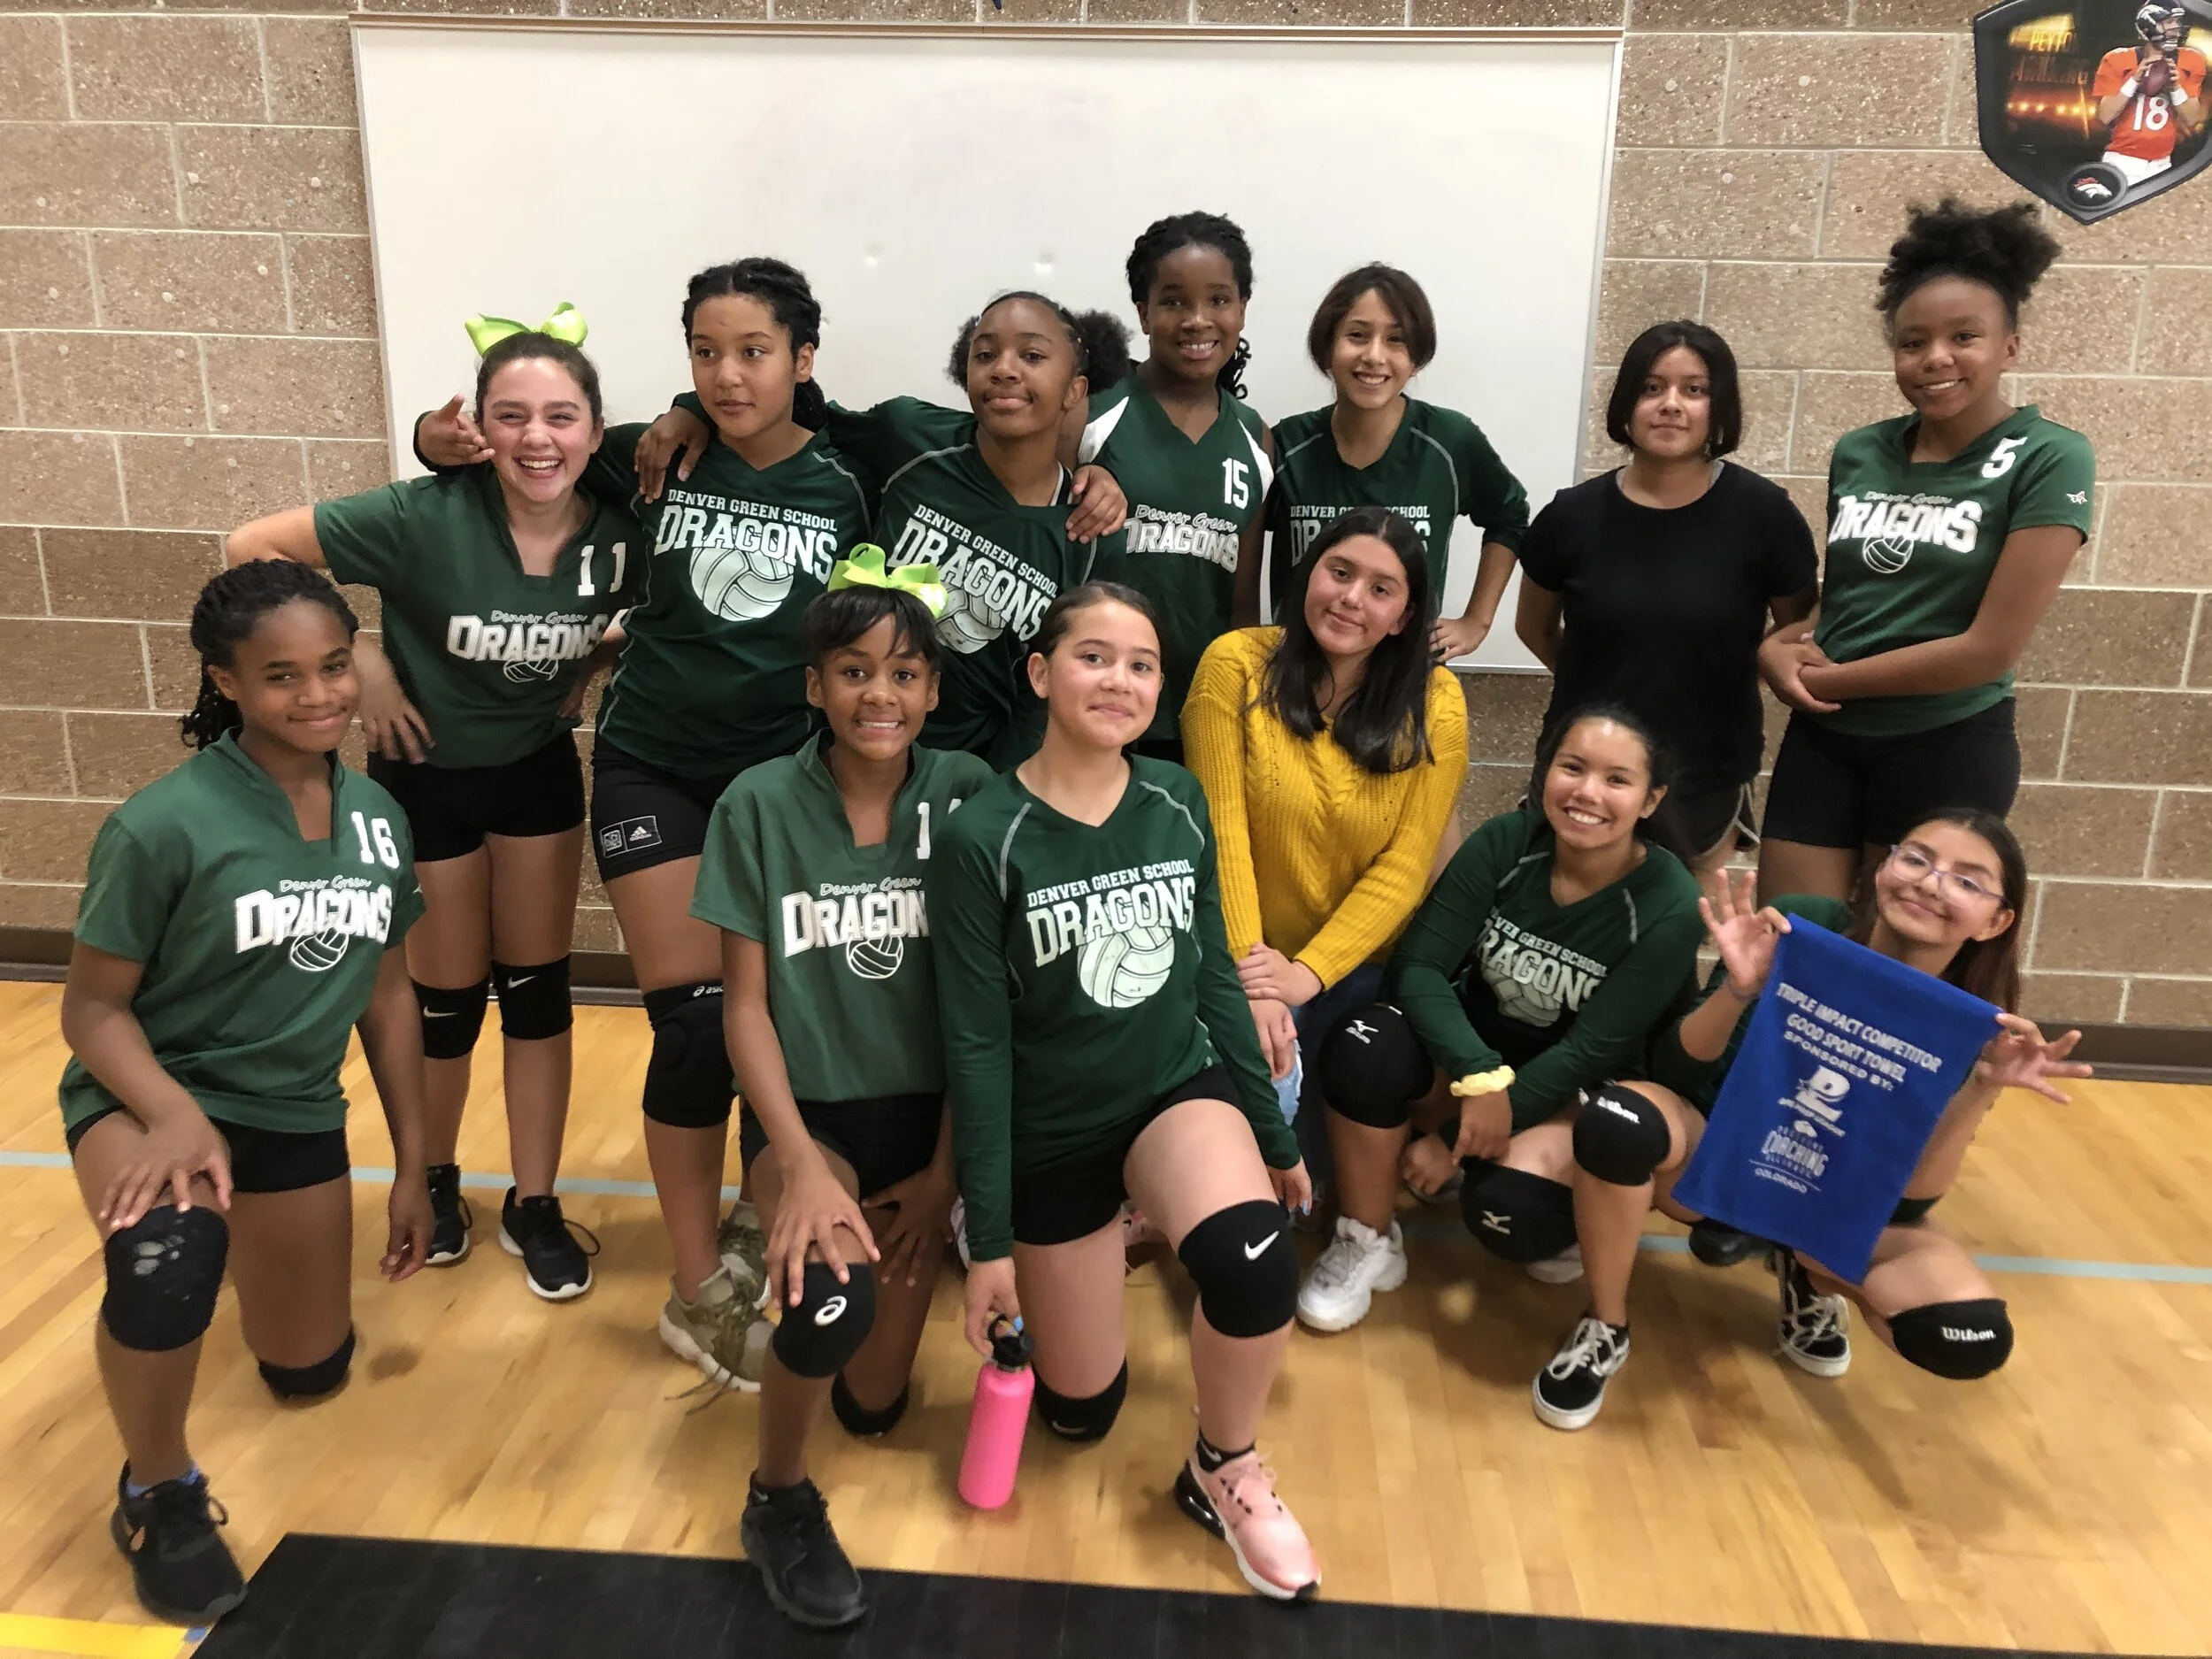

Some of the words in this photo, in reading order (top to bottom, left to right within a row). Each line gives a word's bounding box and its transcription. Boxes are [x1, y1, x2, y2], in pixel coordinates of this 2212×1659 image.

[2132, 95, 2170, 131] 18
[1222, 457, 1249, 510] 15
[1981, 436, 2028, 479] 5
[667, 488, 726, 511] DENVER
[730, 499, 780, 520] GREEN
[783, 509, 838, 532] SCHOOL
[1135, 504, 1191, 525] Denver
[1192, 512, 1238, 533] Green
[1290, 505, 1336, 518] DENVER
[1828, 494, 1984, 554] DRAGONS
[654, 504, 838, 585] DRAGONS
[914, 503, 972, 543] DENVER
[972, 535, 1019, 570] GREEN
[1018, 562, 1058, 598] SCHOOL
[887, 517, 1053, 641] DRAGONS
[490, 610, 542, 624] Denver
[544, 611, 588, 624] Green
[351, 811, 400, 869] 16
[280, 878, 329, 892] Denver
[331, 874, 373, 888] Green
[819, 883, 878, 896] Denver
[879, 876, 922, 891] Green
[1026, 879, 1090, 908] DENVER
[1091, 867, 1141, 892] GREEN
[1142, 858, 1194, 880] SCHOOL
[234, 884, 393, 954] DRAGONS
[781, 890, 930, 957] DRAGON
[1025, 876, 1196, 968] DRAGONS
[1517, 932, 1563, 957] GREEN
[1776, 981, 1818, 1013] TRIPLE
[1815, 1004, 1864, 1035] IMPACT
[1862, 1025, 1944, 1073] COMPETITOR
[1786, 1013, 1825, 1041] GOOD
[1823, 1033, 1865, 1060] SPORT
[1863, 1049, 1908, 1083] TOWEL
[1784, 1030, 1868, 1079] SPONSORED
[1869, 1073, 1895, 1092] BY:
